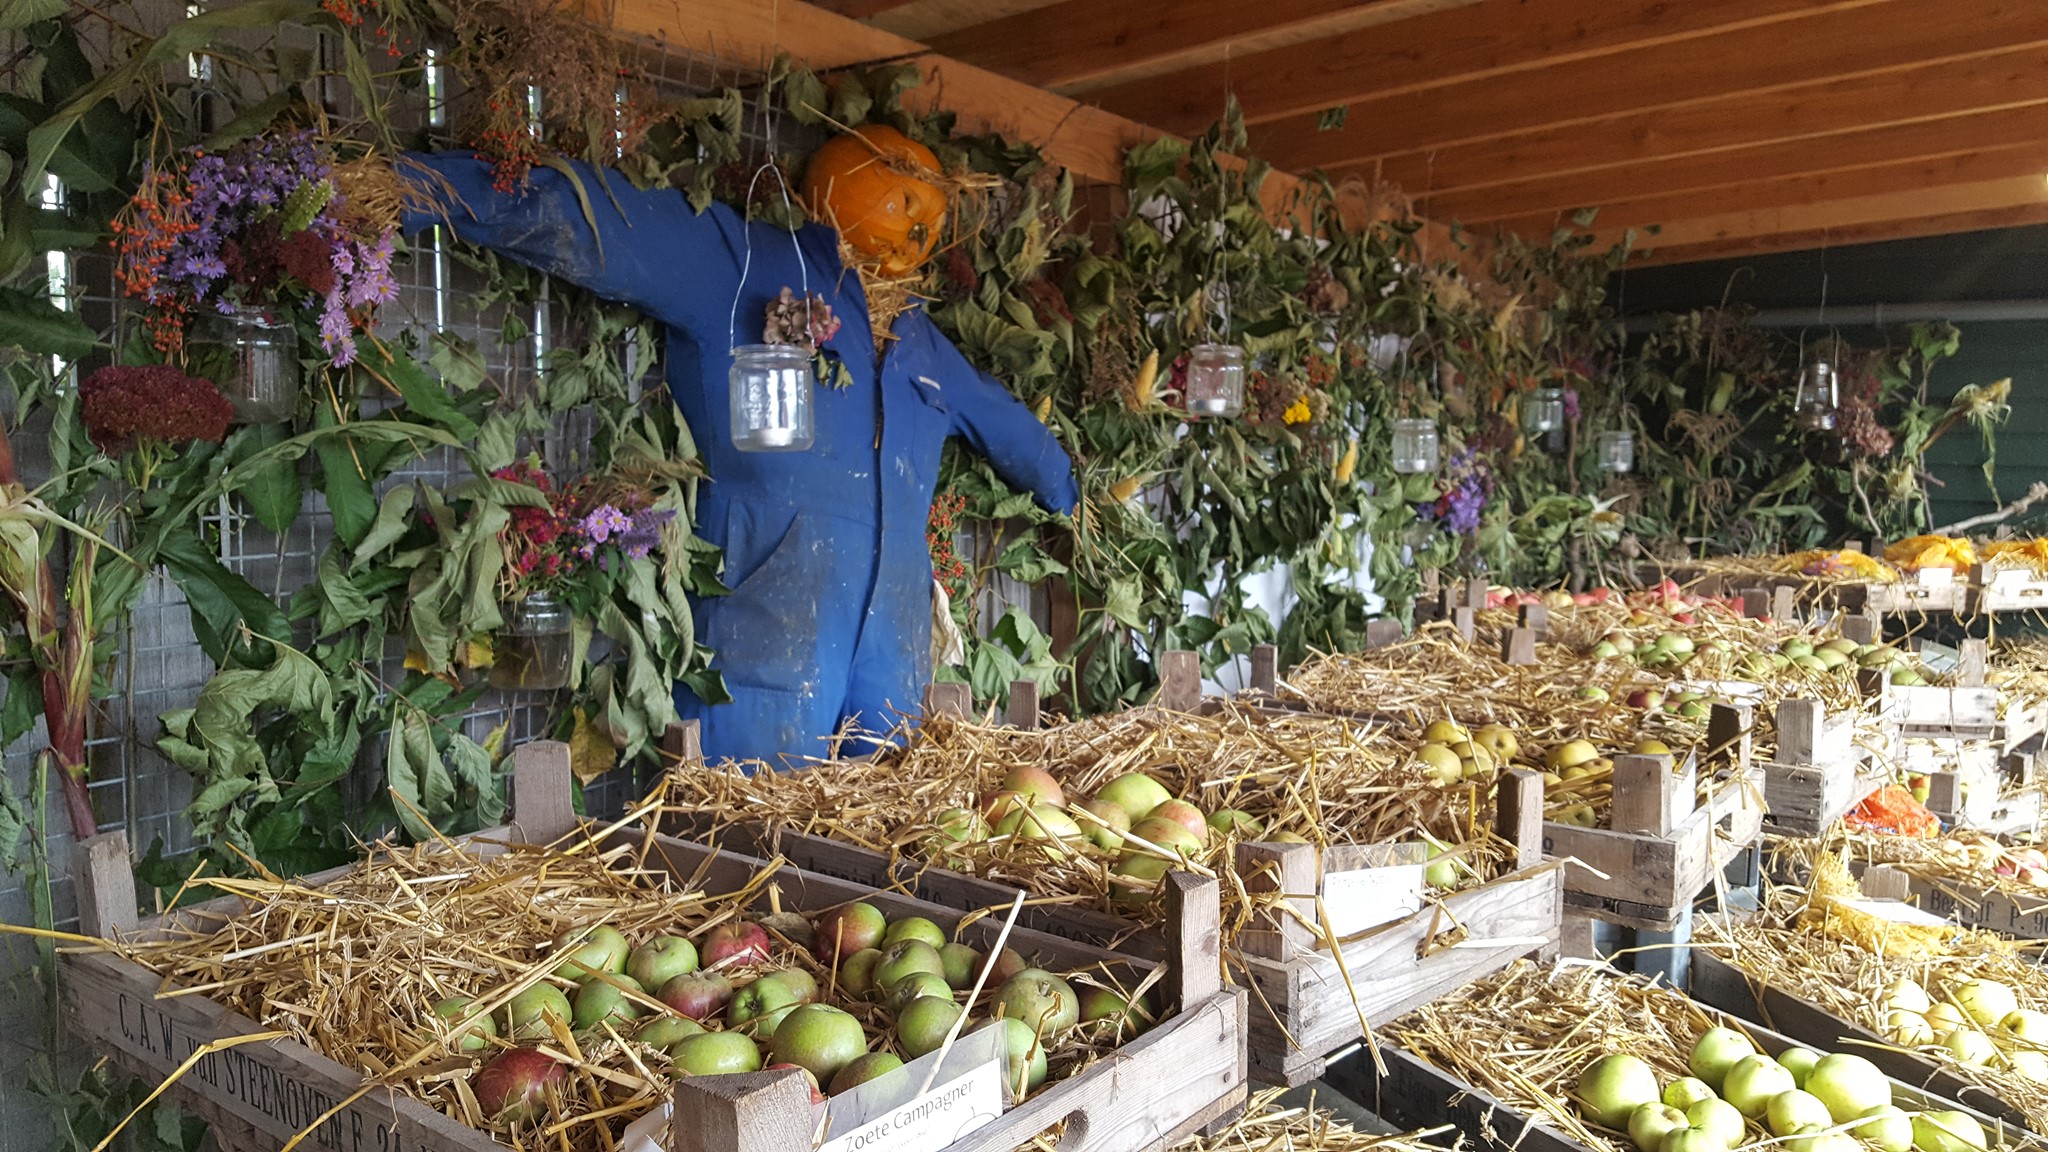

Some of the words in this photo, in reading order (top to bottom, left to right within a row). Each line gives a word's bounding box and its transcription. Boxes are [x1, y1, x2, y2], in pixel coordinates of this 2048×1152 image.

[223, 1047, 342, 1152] STEENOVEN
[845, 1123, 890, 1152] Zoete
[893, 1078, 975, 1131] Campagner
